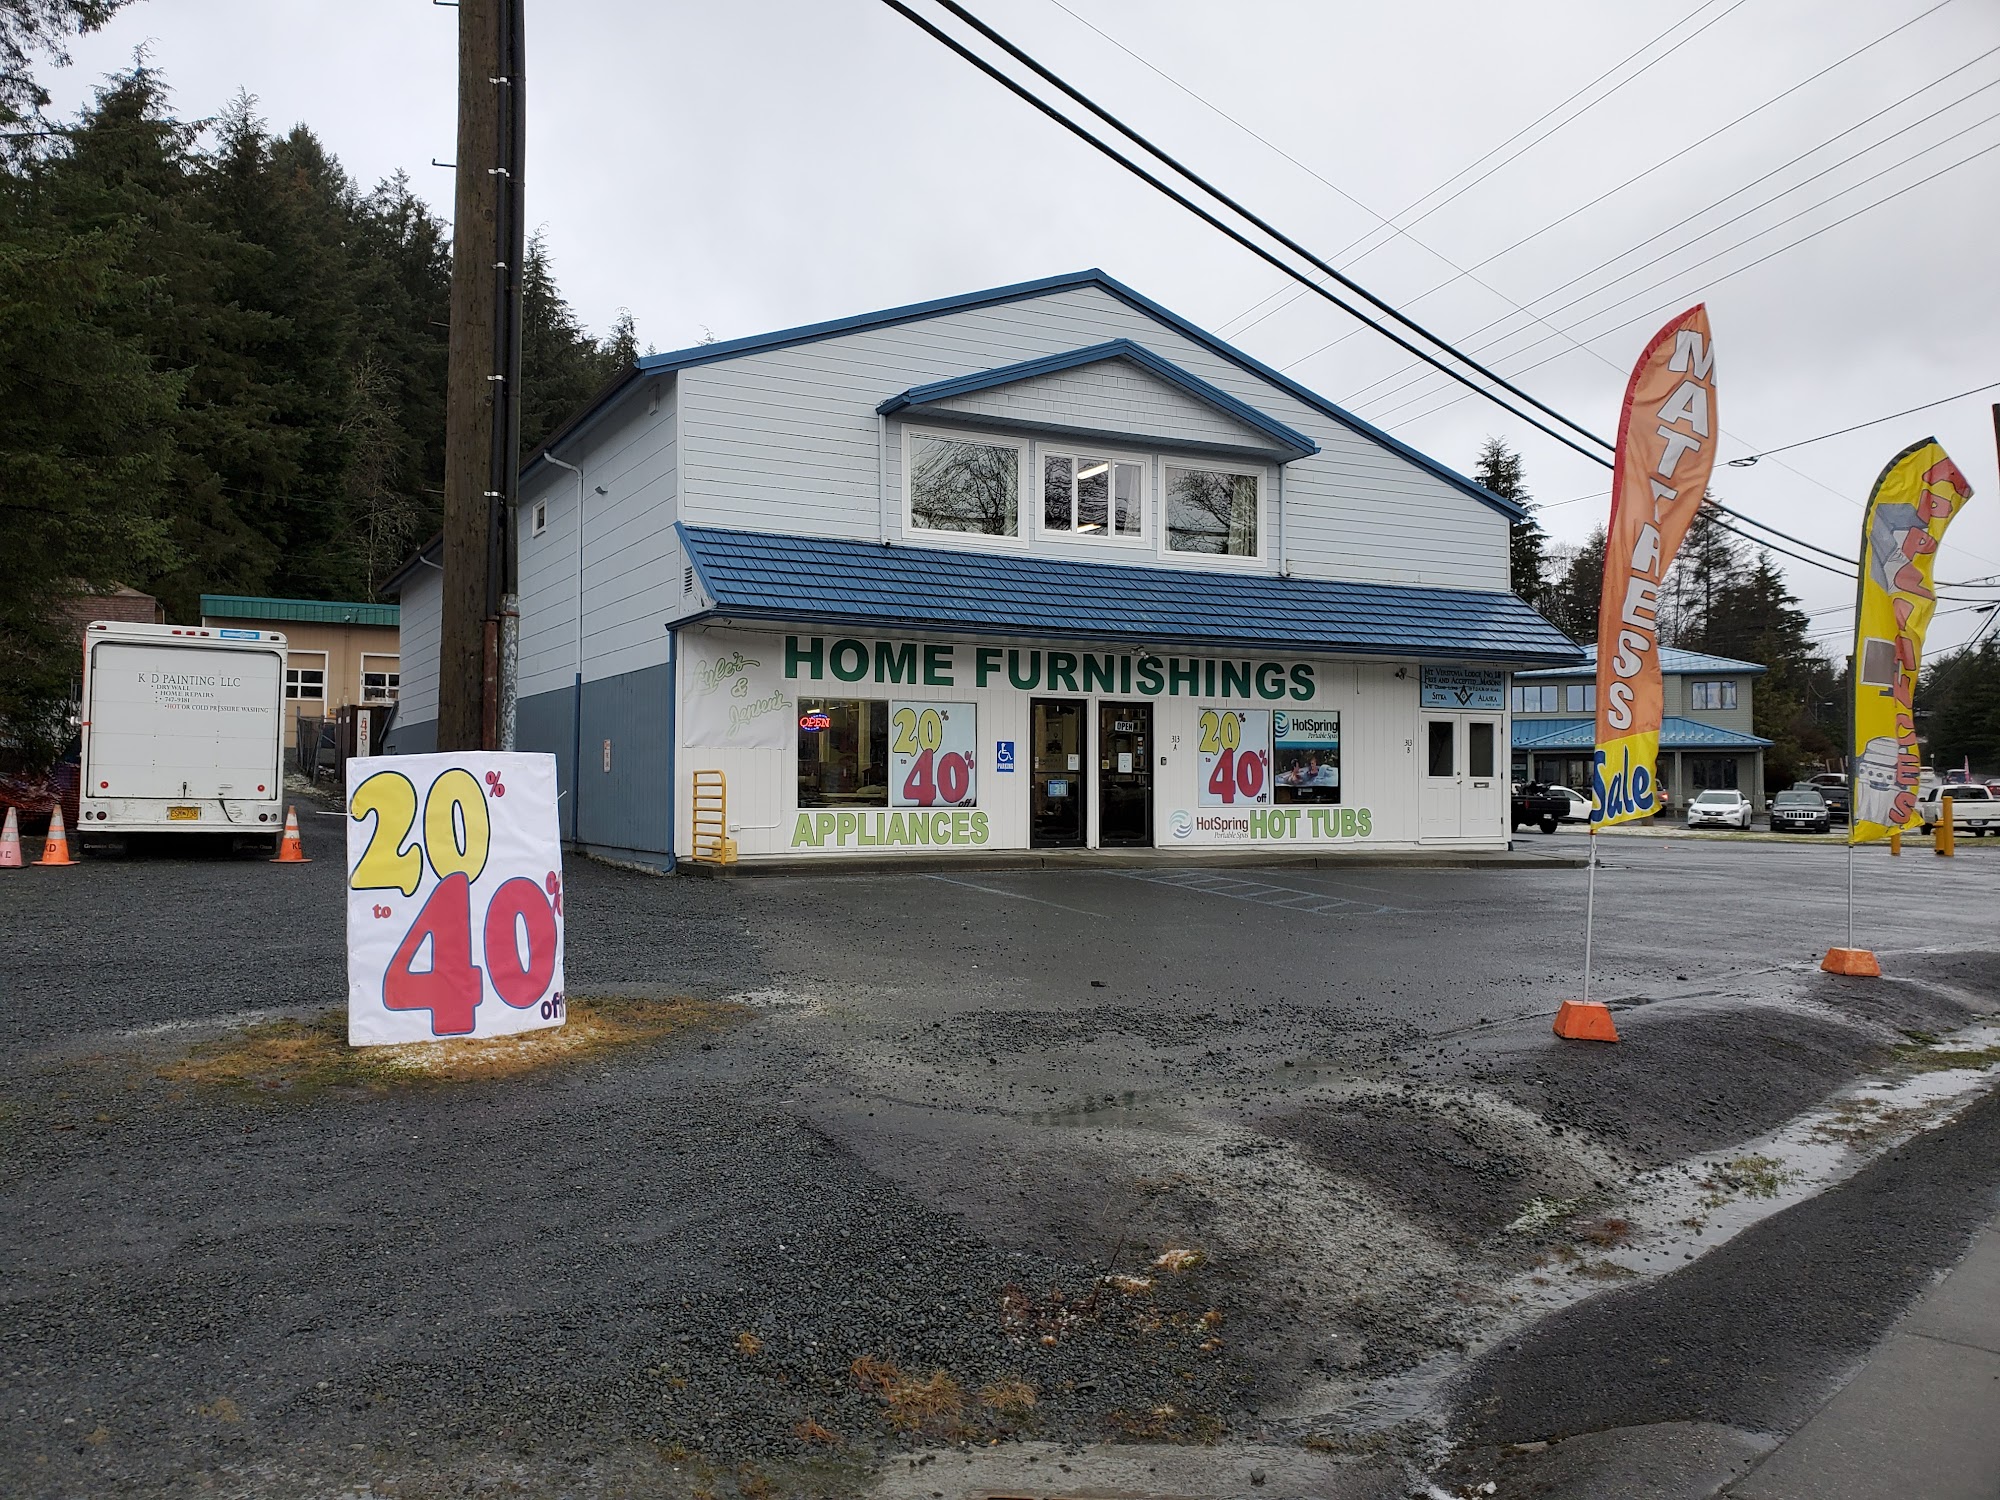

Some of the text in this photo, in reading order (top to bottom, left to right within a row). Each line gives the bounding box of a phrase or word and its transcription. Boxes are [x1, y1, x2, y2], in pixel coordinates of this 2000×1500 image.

[784, 636, 1315, 701] HOME FURNISHINGS
[138, 673, 241, 687] K D PAINTING LLC
[800, 716, 830, 728] OPEN
[1116, 721, 1133, 731] OPEN
[1292, 718, 1338, 733] HotSpring
[1208, 747, 1267, 804] 40%
[1590, 744, 1654, 822] Sale
[791, 812, 989, 847] APPLIANCES
[1196, 816, 1249, 832] HotSpring
[1250, 808, 1373, 839] HOT TUBS
[1214, 831, 1249, 840] Portable Spas
[372, 903, 391, 919] to
